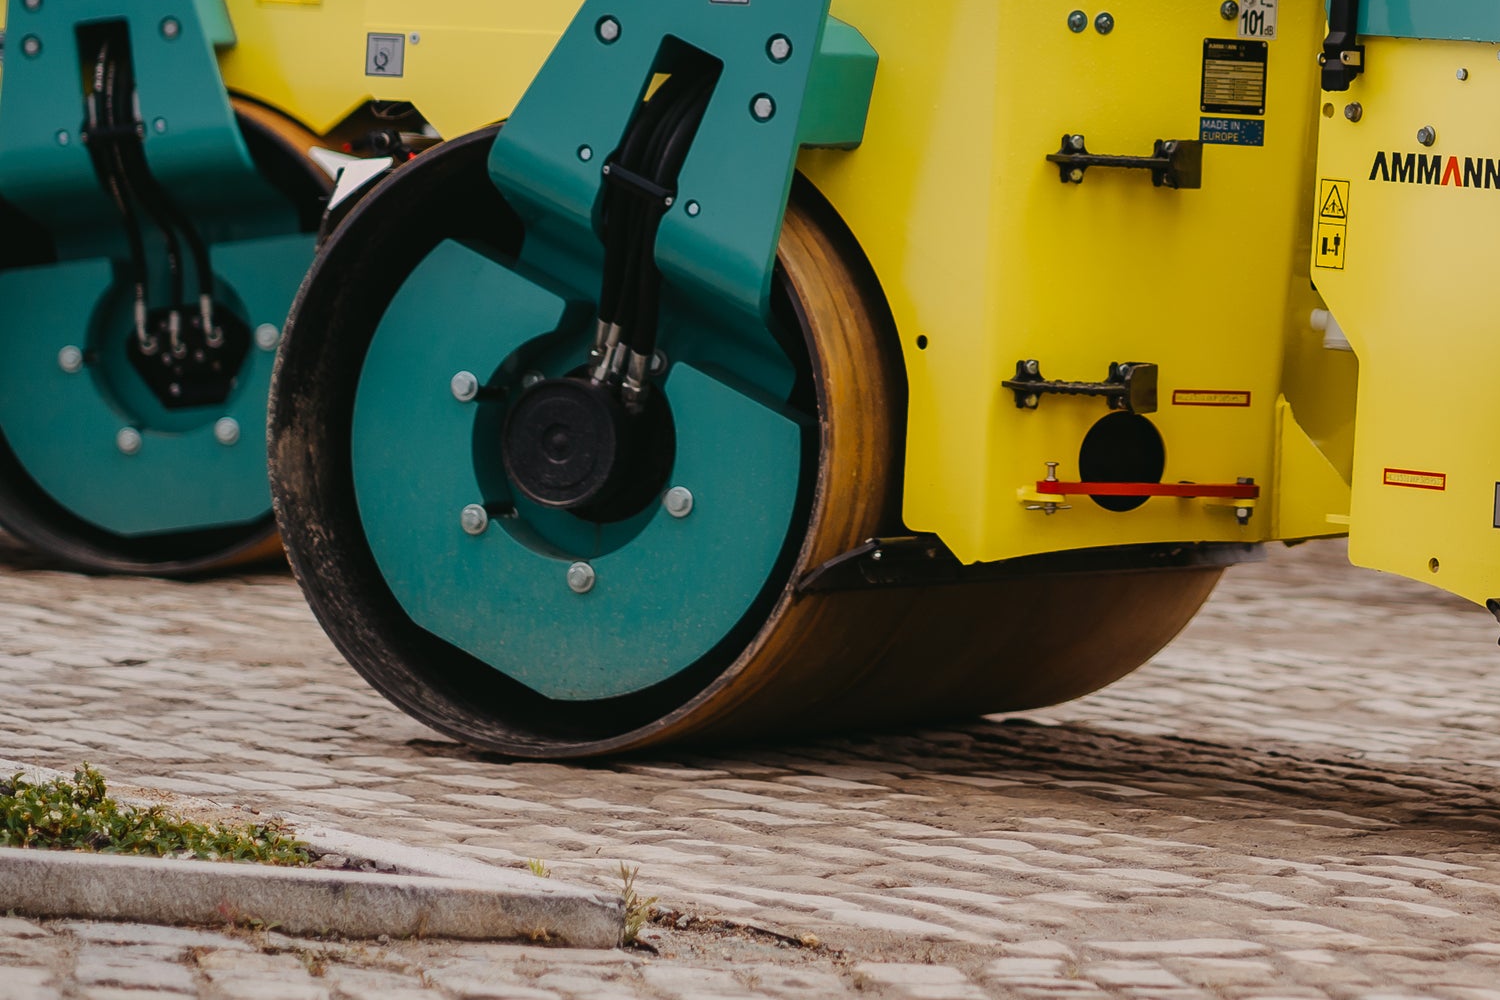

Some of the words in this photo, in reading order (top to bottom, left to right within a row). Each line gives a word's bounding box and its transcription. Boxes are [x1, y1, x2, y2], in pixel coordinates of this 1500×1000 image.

[1242, 9, 1264, 35] 101
[1202, 120, 1228, 130] MADE
[1230, 121, 1240, 131] IN
[1202, 131, 1238, 142] EUROPE
